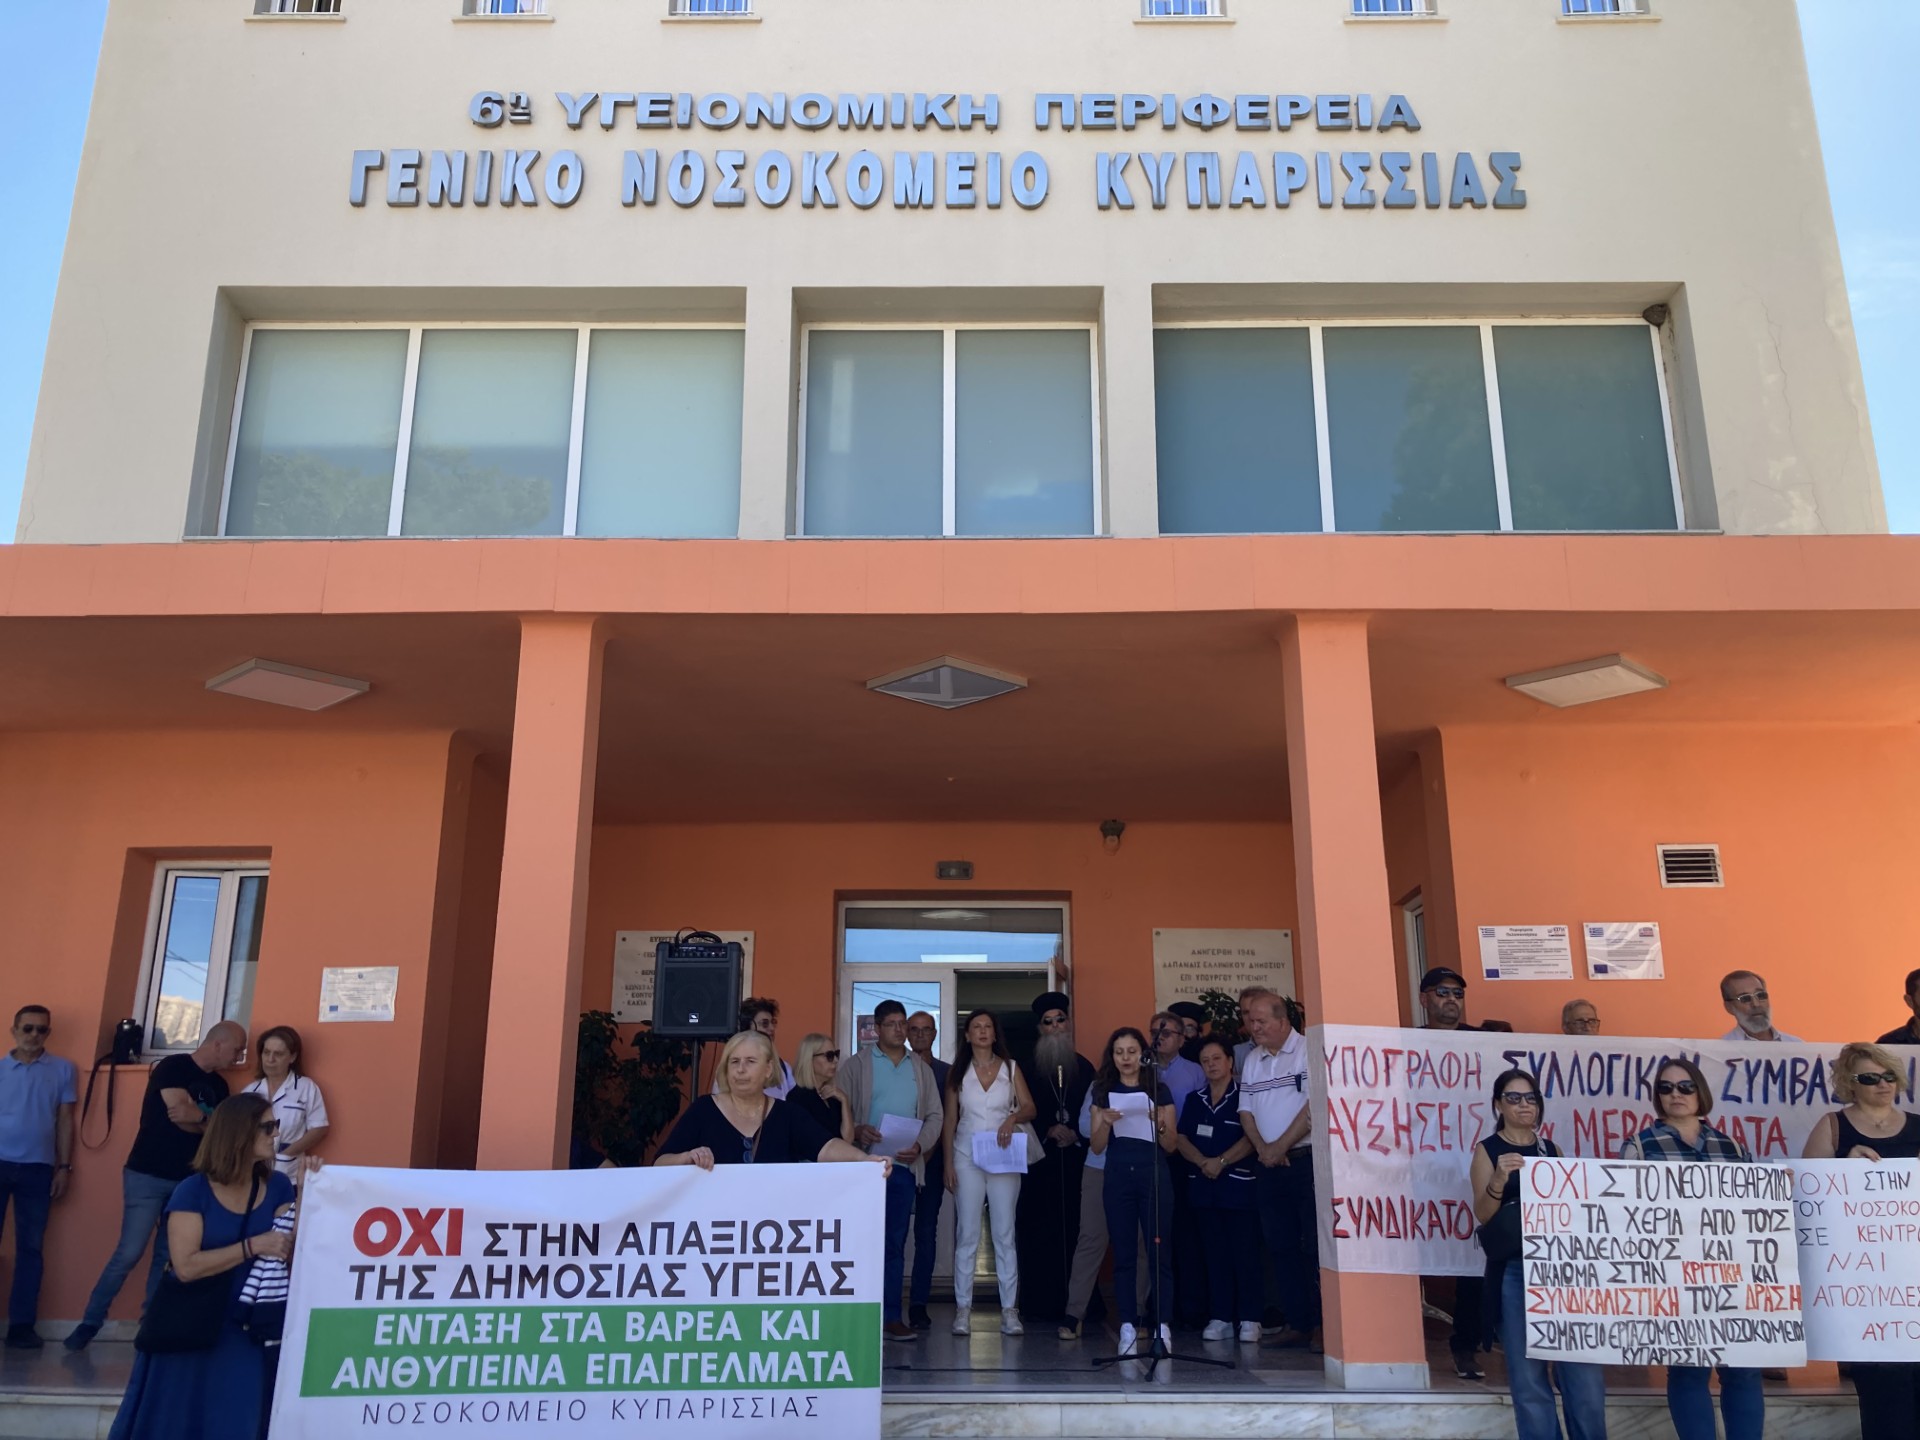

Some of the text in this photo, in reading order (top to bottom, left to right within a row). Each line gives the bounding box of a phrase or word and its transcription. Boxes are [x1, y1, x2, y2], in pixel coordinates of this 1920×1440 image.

[555, 91, 1000, 132] ΥΓΕΙΟΝΟΜΙΚΗ
[1034, 93, 1421, 132] ΠΕΡΙΦΕΡΕΙΑ
[349, 148, 1527, 210] ΓΕΝΙΚΟ ΝΟΣΟΚΟΜΕΙΟ ΚΥΠΑΡΙΣΣΙΑΣ
[1322, 1045, 1482, 1091] ΥΠΟΓΡΑΦΗ
[1503, 1050, 1700, 1101] ΣΥΛΛΟΓΙΚ
[1531, 1160, 1589, 1200] ΟΧΙ
[1598, 1164, 1660, 1201] ΣΤΟ
[1800, 1171, 1911, 1196] ΟΧΙ ΣΤΗΝ
[353, 1206, 842, 1258] ΟΧΙ ΣΤΗΝ ΑΠΑΞΙΩΣΗ
[1331, 1195, 1474, 1241] ΣΥΝΔΙΚΑΤΟ
[1581, 1204, 1609, 1233] ΤΑ
[1624, 1206, 1683, 1235] ΧΕΡΙΑ
[1700, 1208, 1735, 1235] ΑΠΟ
[1742, 1209, 1791, 1233] ΤΟΥΣ
[1524, 1235, 1779, 1264] ΣΥΝΑΔΕΛΦΟΥΣ ΚΑΙ ΤΟ
[1798, 1224, 1920, 1247] ΣΕ ΚΕΝΤΡ
[1606, 1261, 1667, 1285] ΣΤΗΝ
[1681, 1261, 1743, 1285] ΚΡΙΤΙΚΗ
[1751, 1264, 1778, 1284] ΚΑΙ
[1827, 1252, 1886, 1272] ΝΑΙ
[349, 1260, 856, 1301] ΤΗΣ ΔΗΜΟΣΙΑΣ ΥΓΕΙΑΣ
[1685, 1284, 1738, 1314] ΤΟΥΣ
[1745, 1285, 1802, 1313] ΔΡΑΣΗ
[374, 1309, 820, 1346] ΕΝΤΑΞΗ ΣΤΑ ΒΑΡΕΑ ΚΑΙ
[331, 1351, 854, 1390] ΑΝΘΥΓΙΕΙΝΑ ΕΠΑΓΓΕΛΜΑΤΑ
[1621, 1347, 1729, 1368] ΚΥΠΑΡΙΣΣΙΑΣ
[361, 1396, 819, 1426] ΝΟΣΟΚΟΜΕΙΟ ΚΥΠΑΡΙΣΣΙΑΣ
